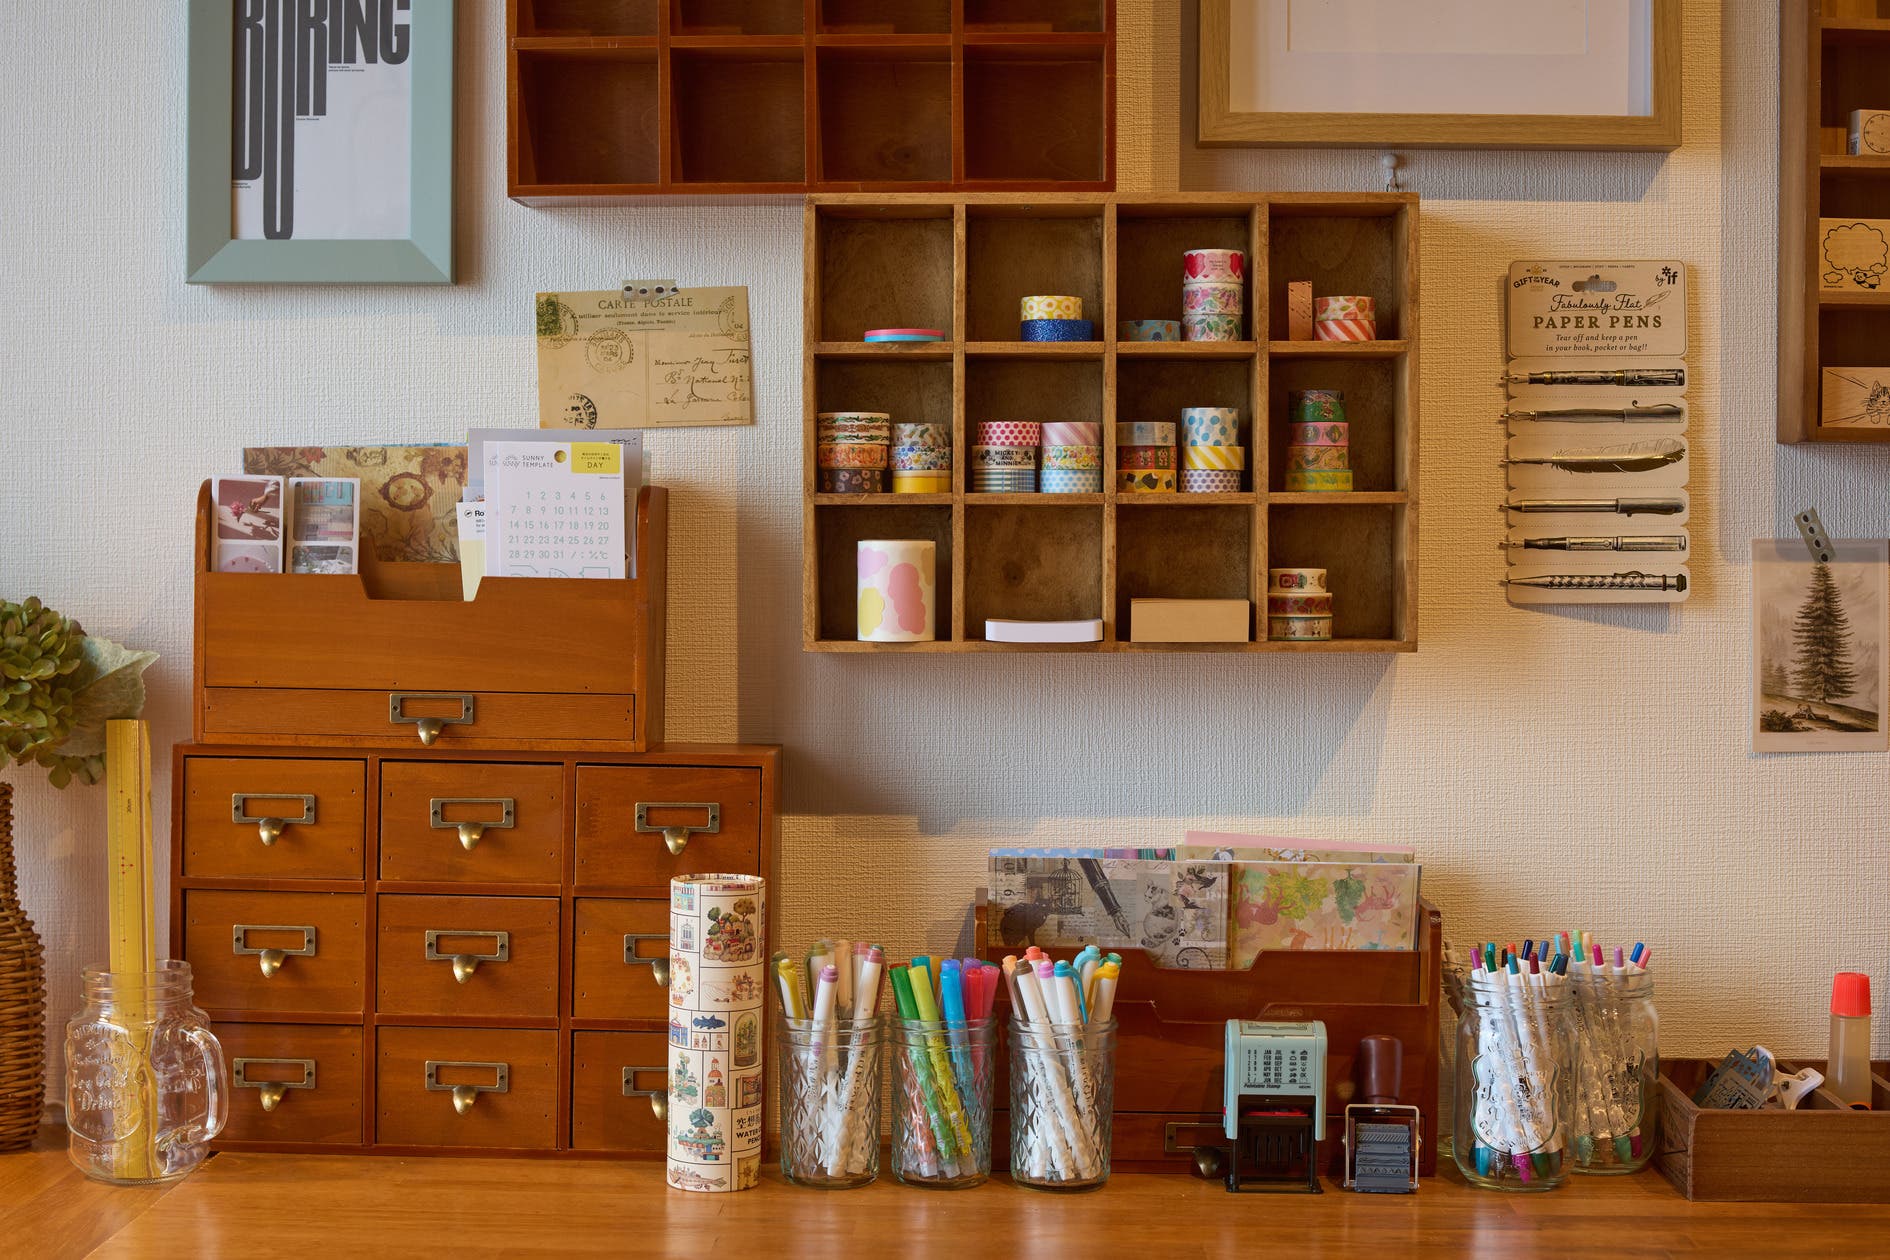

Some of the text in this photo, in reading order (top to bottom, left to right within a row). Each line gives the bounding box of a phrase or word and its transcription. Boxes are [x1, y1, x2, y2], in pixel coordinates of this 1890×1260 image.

[1514, 276, 1533, 288] GIFT
[1540, 276, 1560, 288] YEAR
[1655, 274, 1666, 287] by
[598, 298, 693, 310] CARTE POSTALE
[1550, 294, 1642, 314] Fabulously Flat
[1533, 315, 1662, 328] PAPER PENS
[1573, 334, 1584, 342] off
[1601, 334, 1617, 342] keep
[1594, 344, 1617, 352] pocket
[1629, 344, 1648, 352] bag!!
[541, 491, 546, 500] 2
[555, 491, 560, 500] 3
[570, 492, 576, 500] 4
[585, 492, 591, 500] 5
[600, 492, 606, 500] 6
[511, 505, 609, 516] 7 8 9 10 11 12 13
[509, 521, 609, 530] 14 15 16 17 18 19 20
[508, 535, 609, 545] 21 22 23 24 25 26 27
[509, 550, 520, 558] 28
[524, 550, 535, 559] 29
[539, 550, 550, 559] 30
[553, 551, 564, 559] 31
[736, 1113, 760, 1129] 空想
[748, 1135, 761, 1144] PENC
